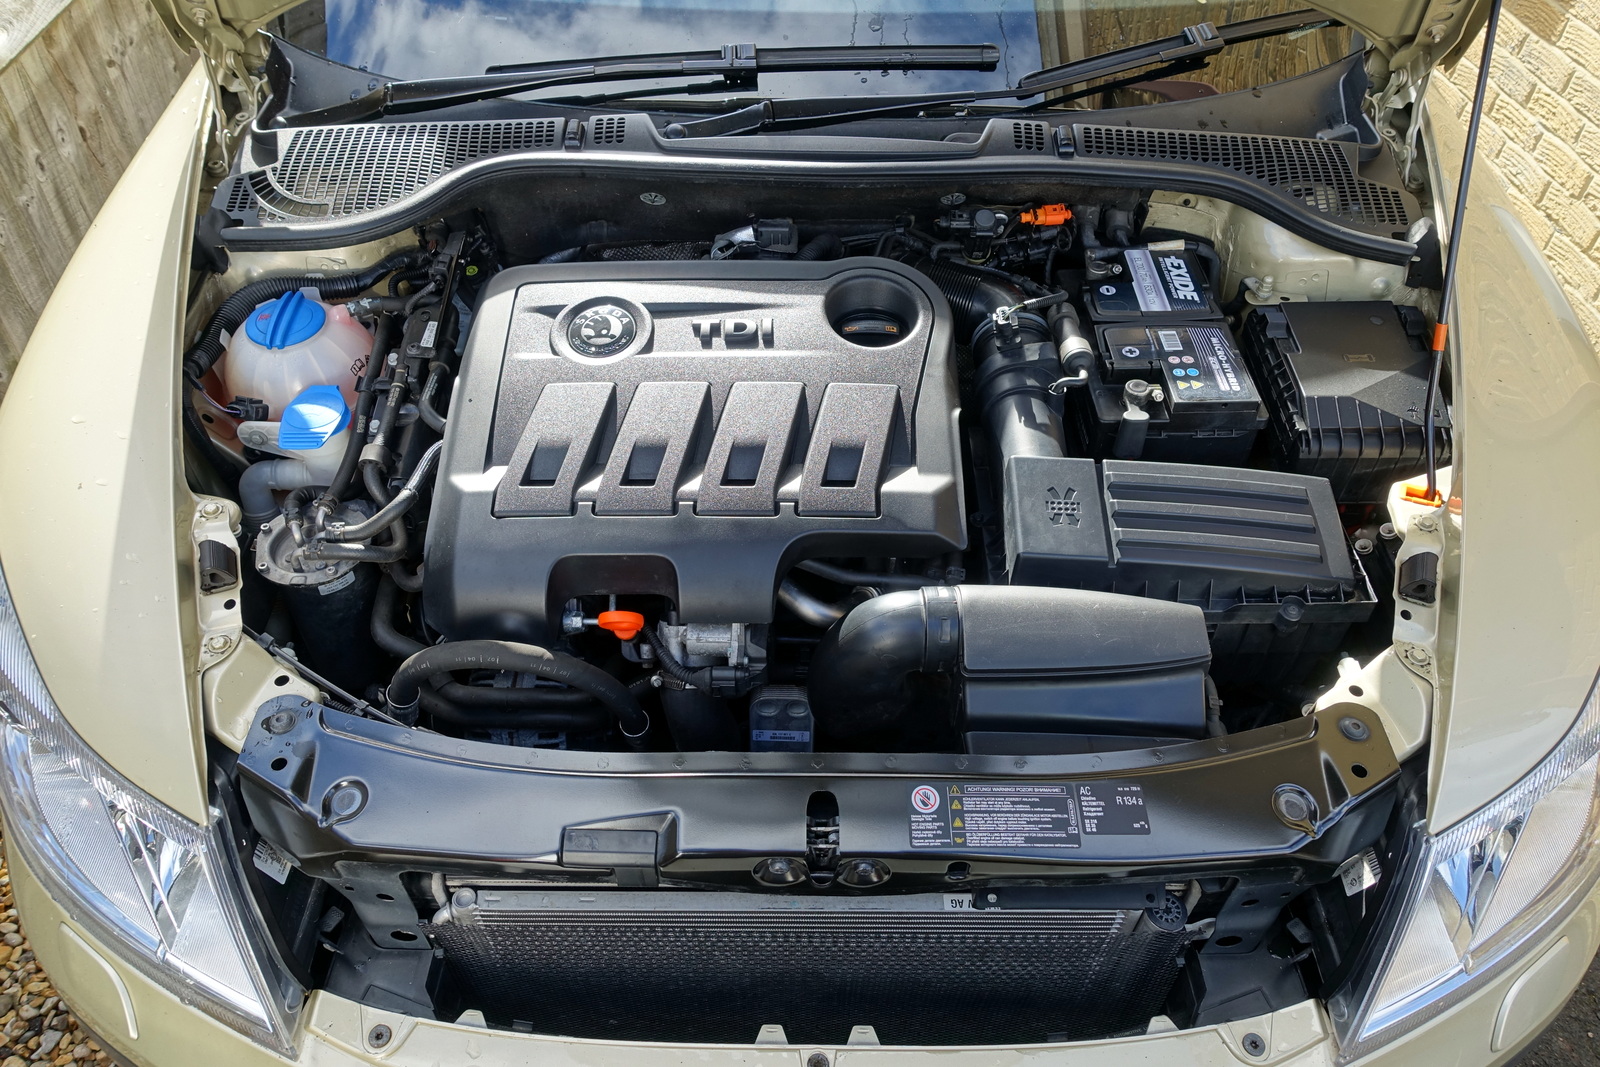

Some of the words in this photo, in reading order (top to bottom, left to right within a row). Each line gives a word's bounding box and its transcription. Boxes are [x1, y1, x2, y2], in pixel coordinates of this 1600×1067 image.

[1164, 256, 1199, 301] EXIDE
[692, 318, 774, 347] TDI
[1210, 337, 1242, 391] MICRO-HYBRID
[1080, 786, 1091, 795] AC
[1116, 796, 1123, 805] R
[1123, 796, 1137, 805] 134
[951, 899, 964, 908] AG
